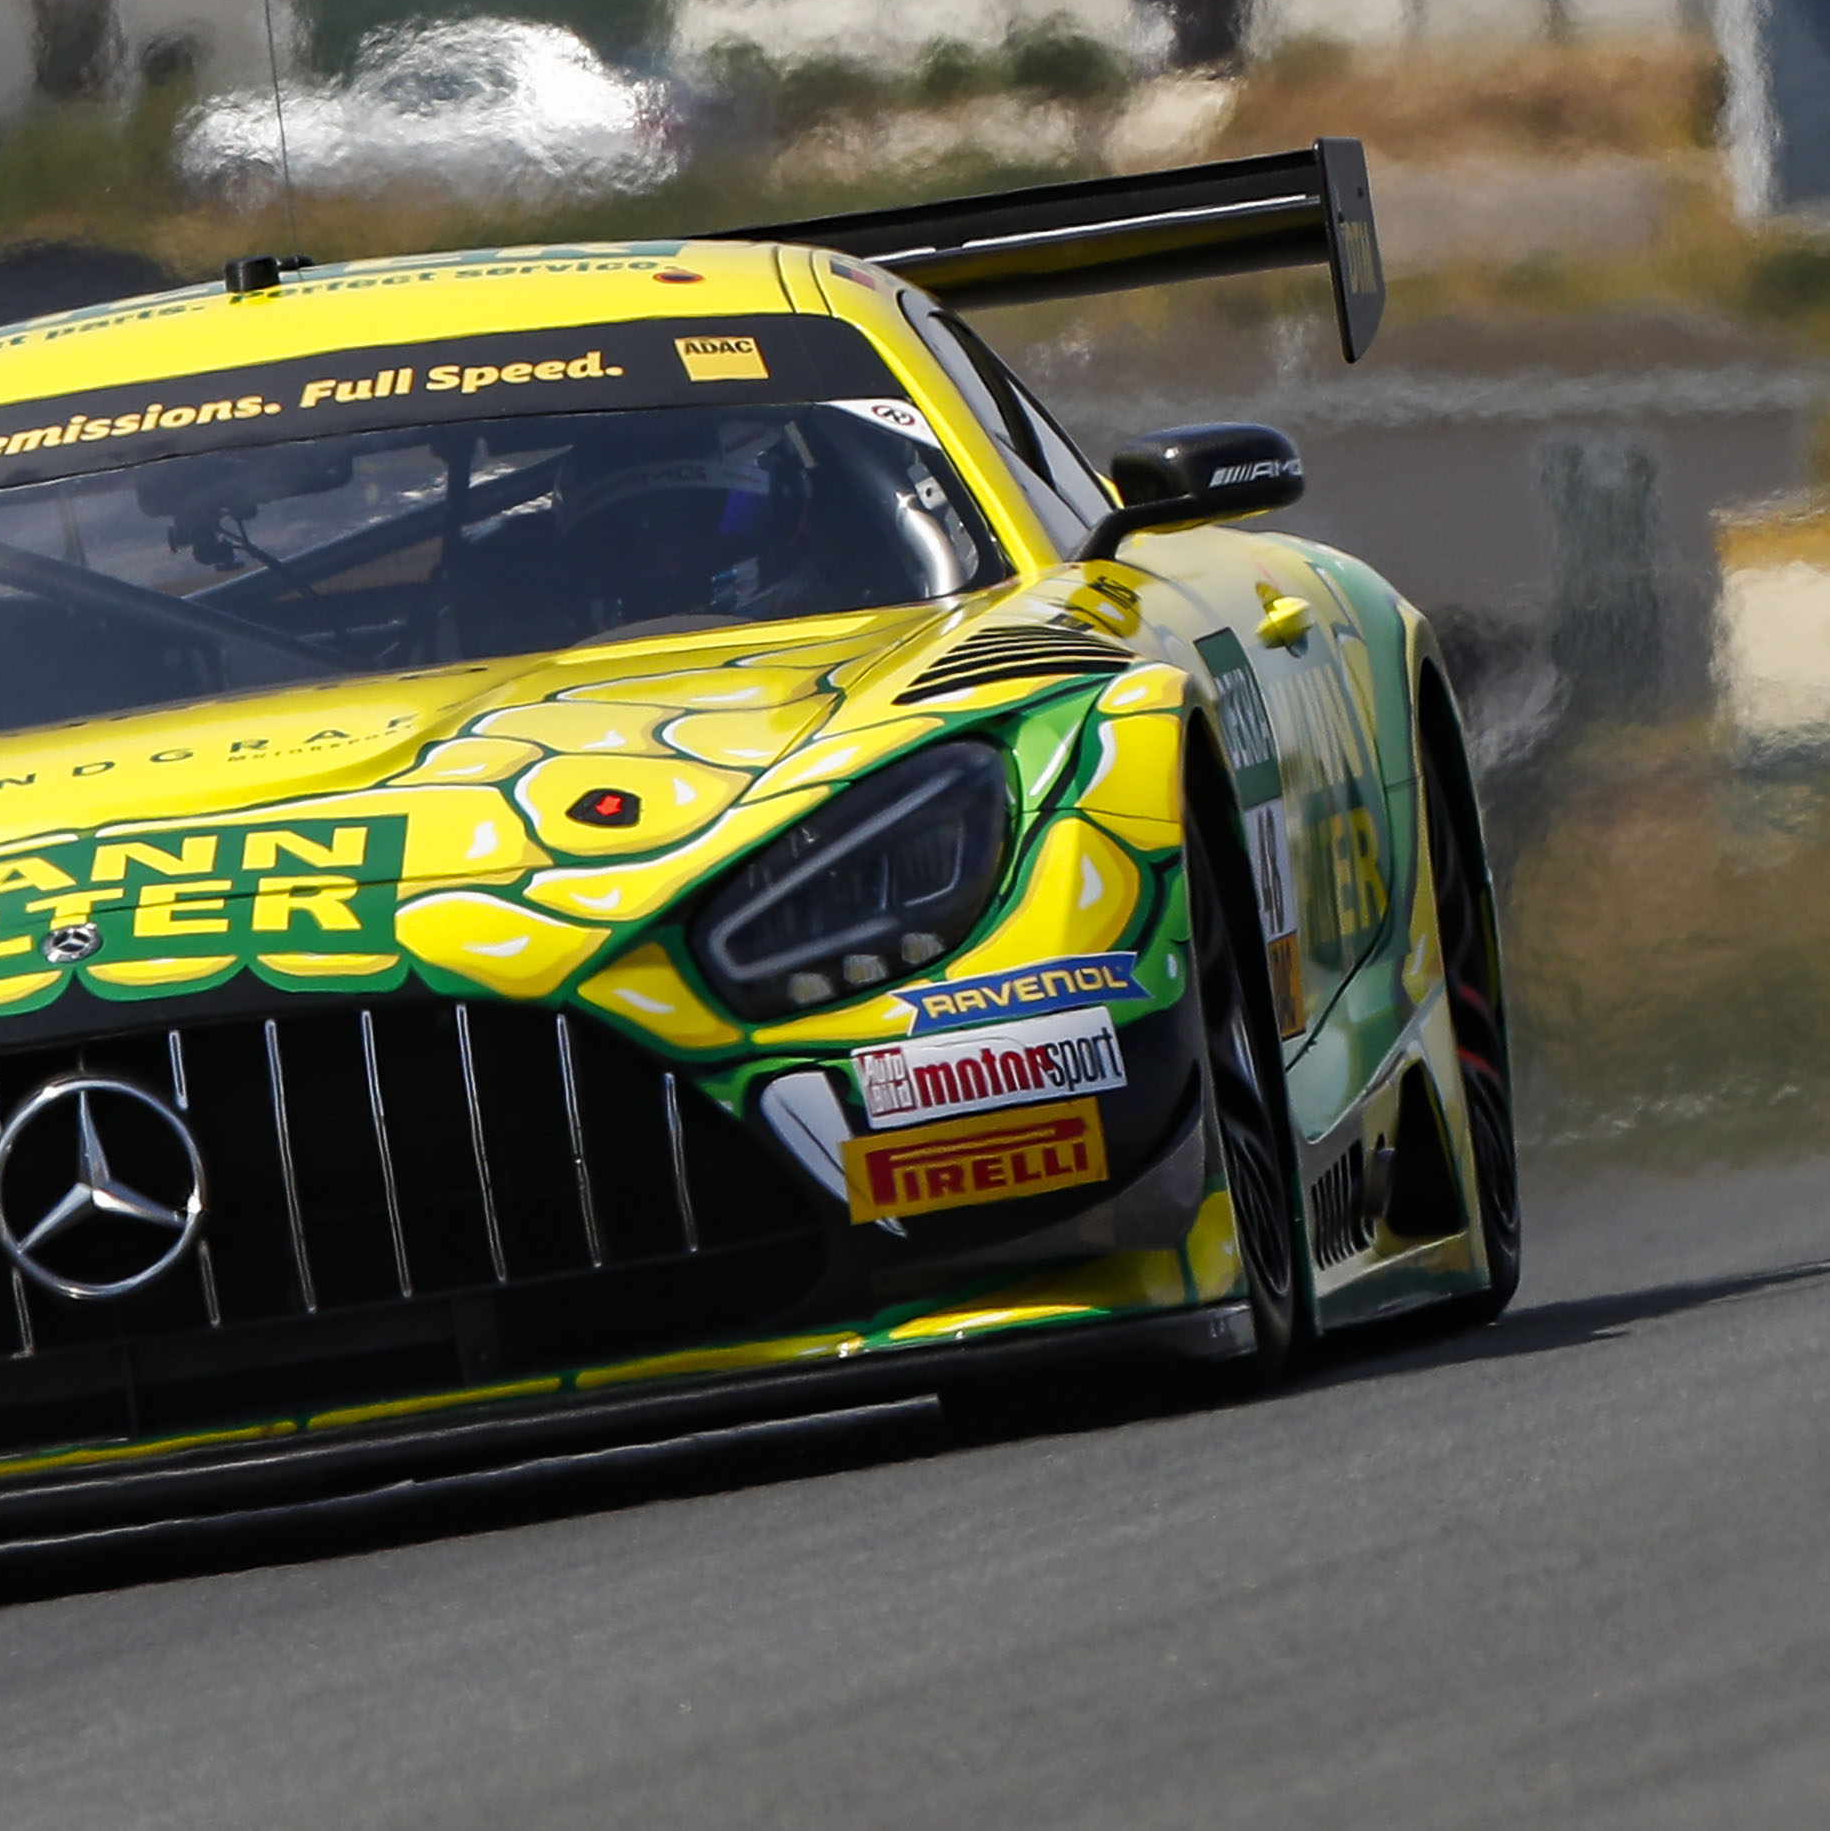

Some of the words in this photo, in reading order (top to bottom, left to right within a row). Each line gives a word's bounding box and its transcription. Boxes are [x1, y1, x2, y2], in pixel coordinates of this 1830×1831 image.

[683, 339, 754, 356] ADAC
[299, 367, 414, 410] Full
[425, 351, 625, 395] Speed.
[227, 723, 415, 764] MOTORSPORT
[921, 966, 1129, 1019] RAVENOL
[912, 1027, 1123, 1108] motorsport
[864, 1117, 1090, 1207] PIRELLI
